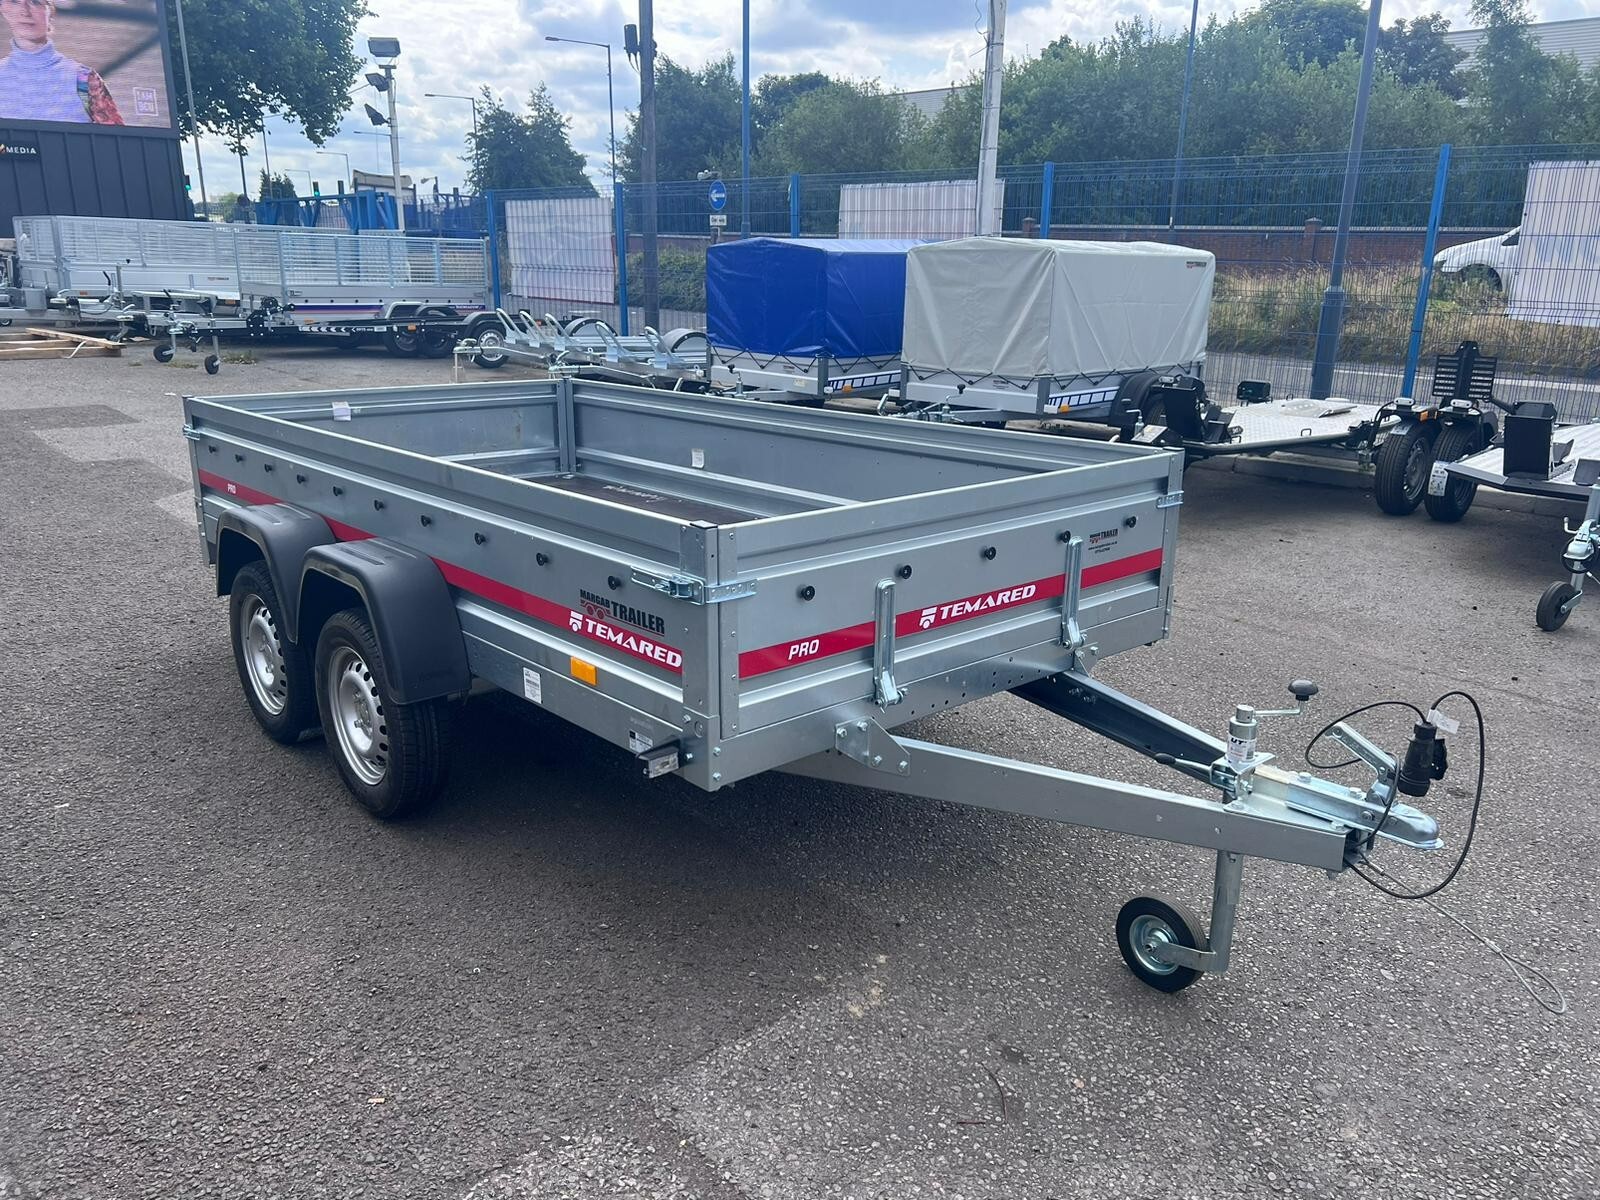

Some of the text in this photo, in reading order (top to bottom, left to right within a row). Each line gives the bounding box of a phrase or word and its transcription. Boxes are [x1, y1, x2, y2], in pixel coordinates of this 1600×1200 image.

[227, 482, 237, 494] PRO
[580, 589, 611, 608] MARGAB
[939, 584, 1037, 621] TEMARED
[611, 601, 665, 634] TRAILER
[585, 618, 682, 668] TEMARED
[788, 639, 820, 660] PRO
